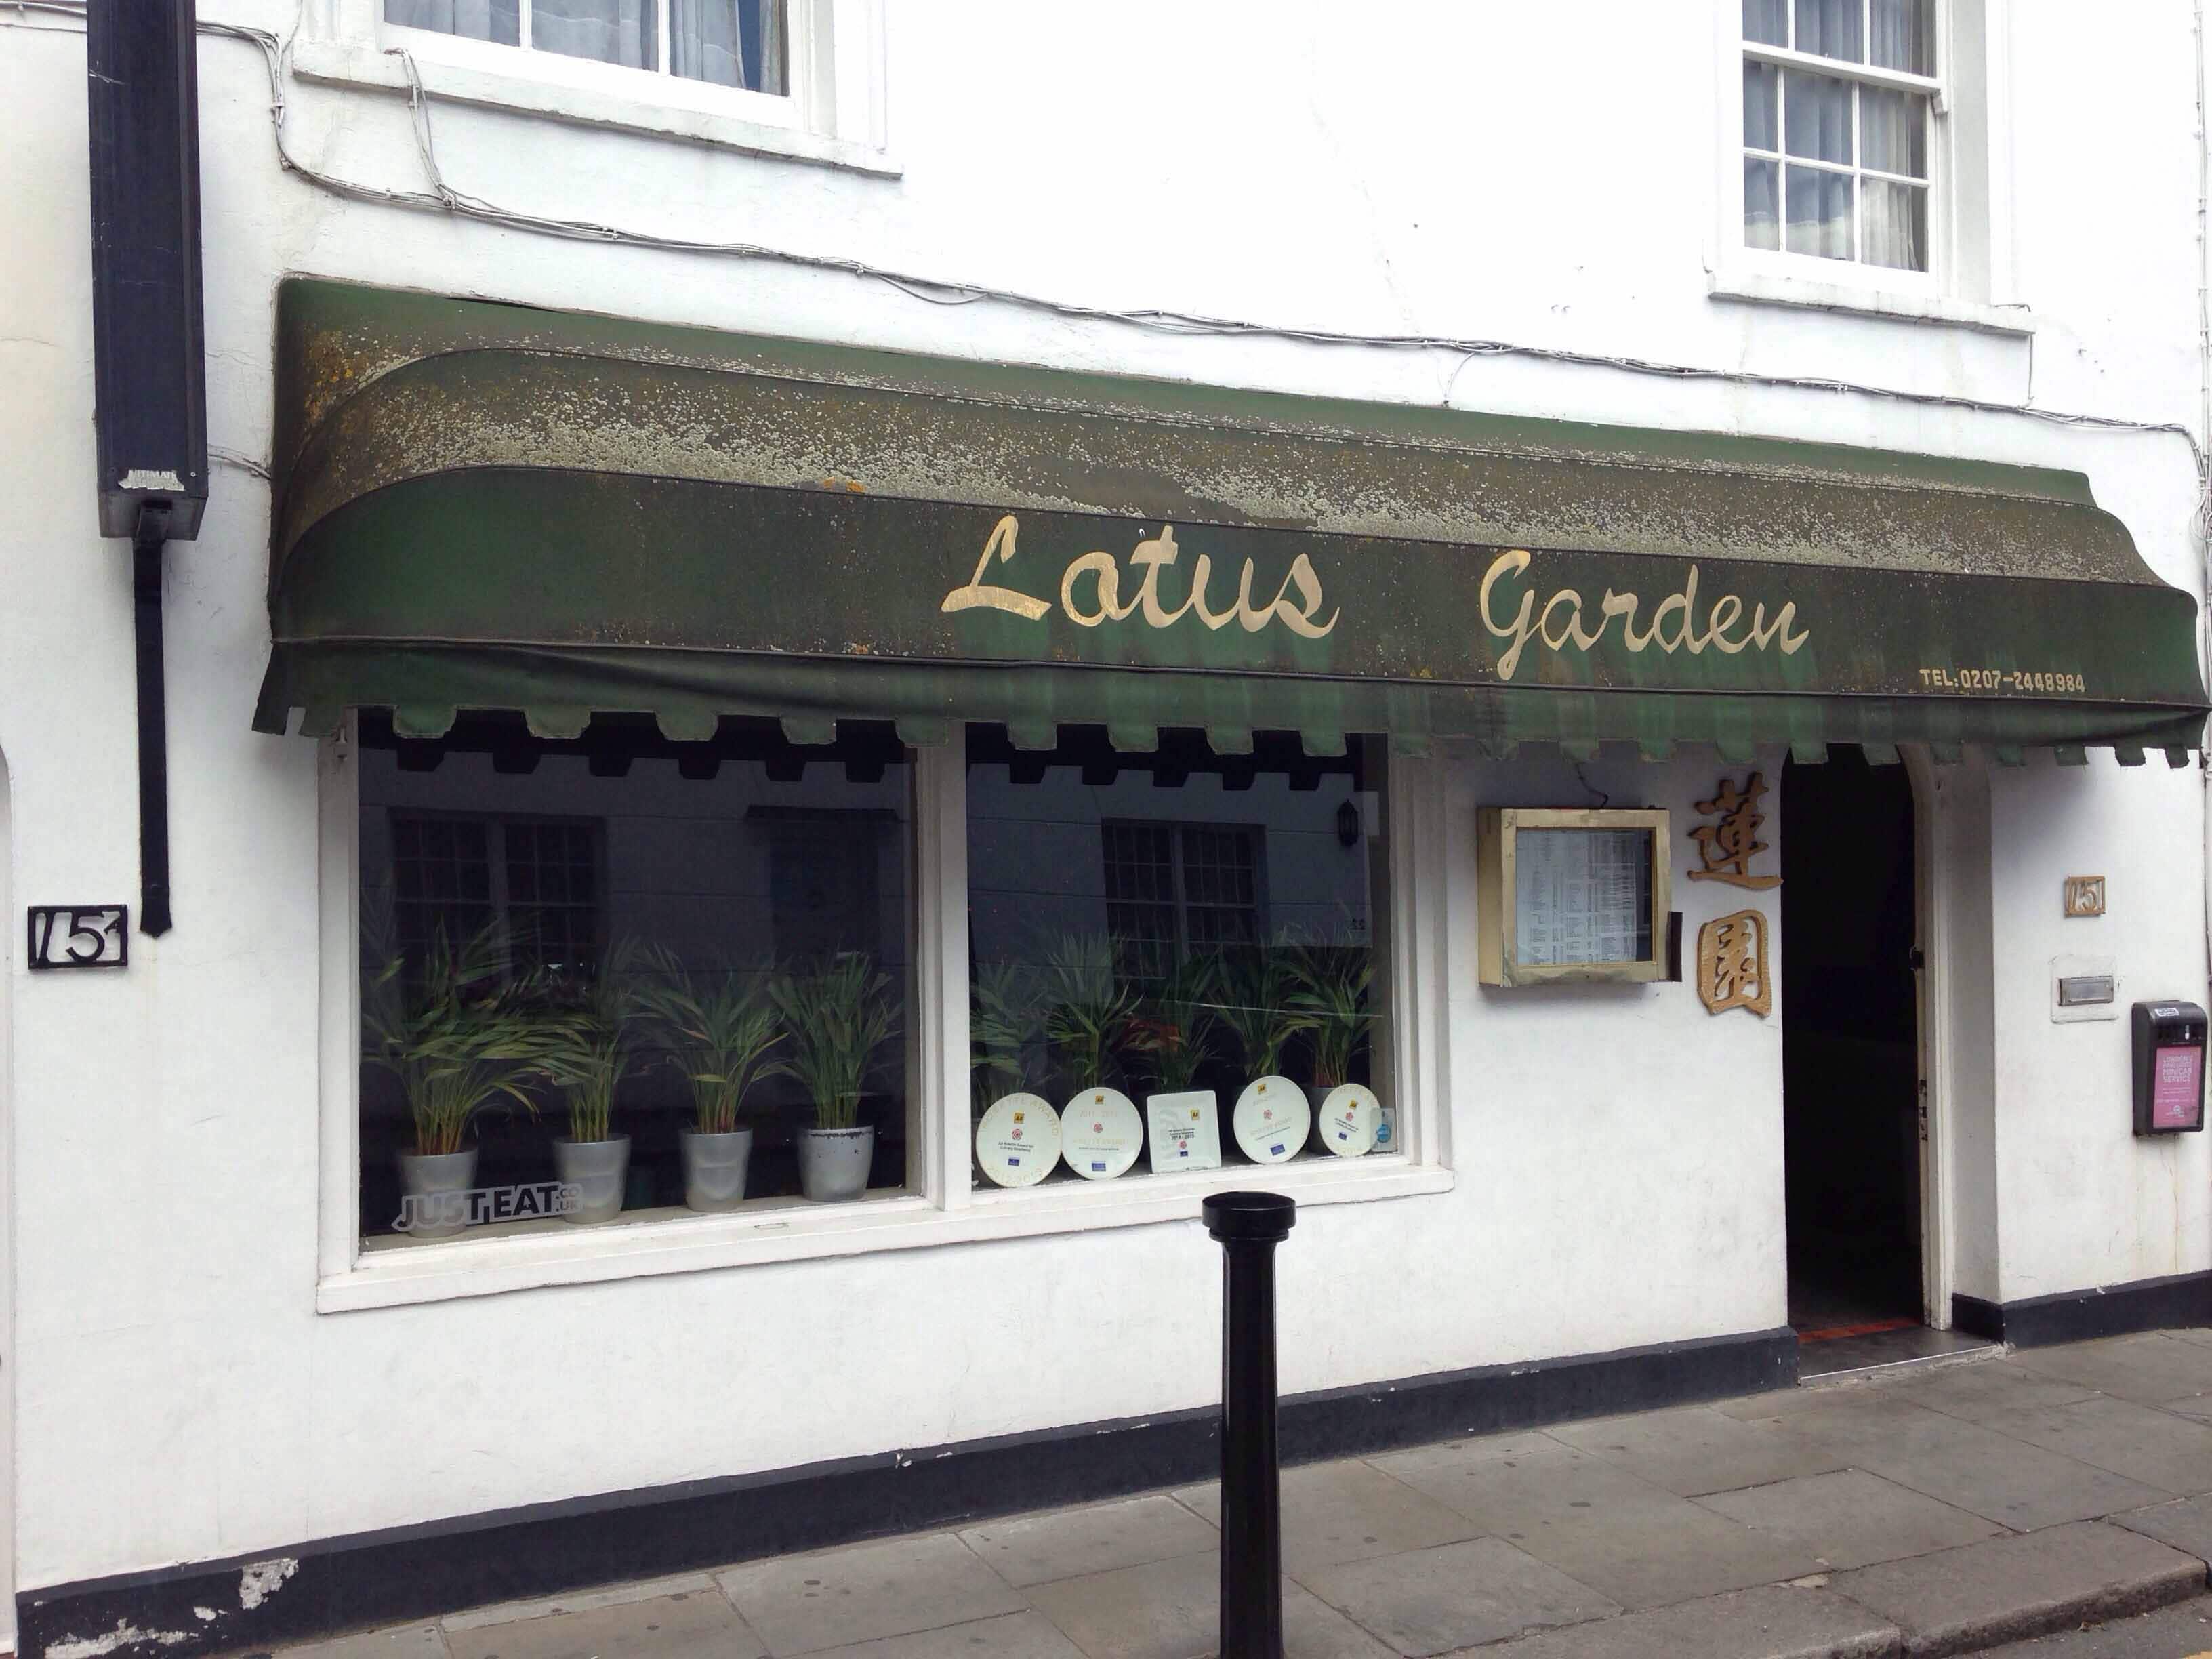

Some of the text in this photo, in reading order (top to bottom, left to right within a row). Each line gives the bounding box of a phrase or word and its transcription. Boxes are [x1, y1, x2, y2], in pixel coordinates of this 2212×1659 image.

[1480, 550, 1810, 680] Garden
[395, 1185, 559, 1228] JUST EAT
